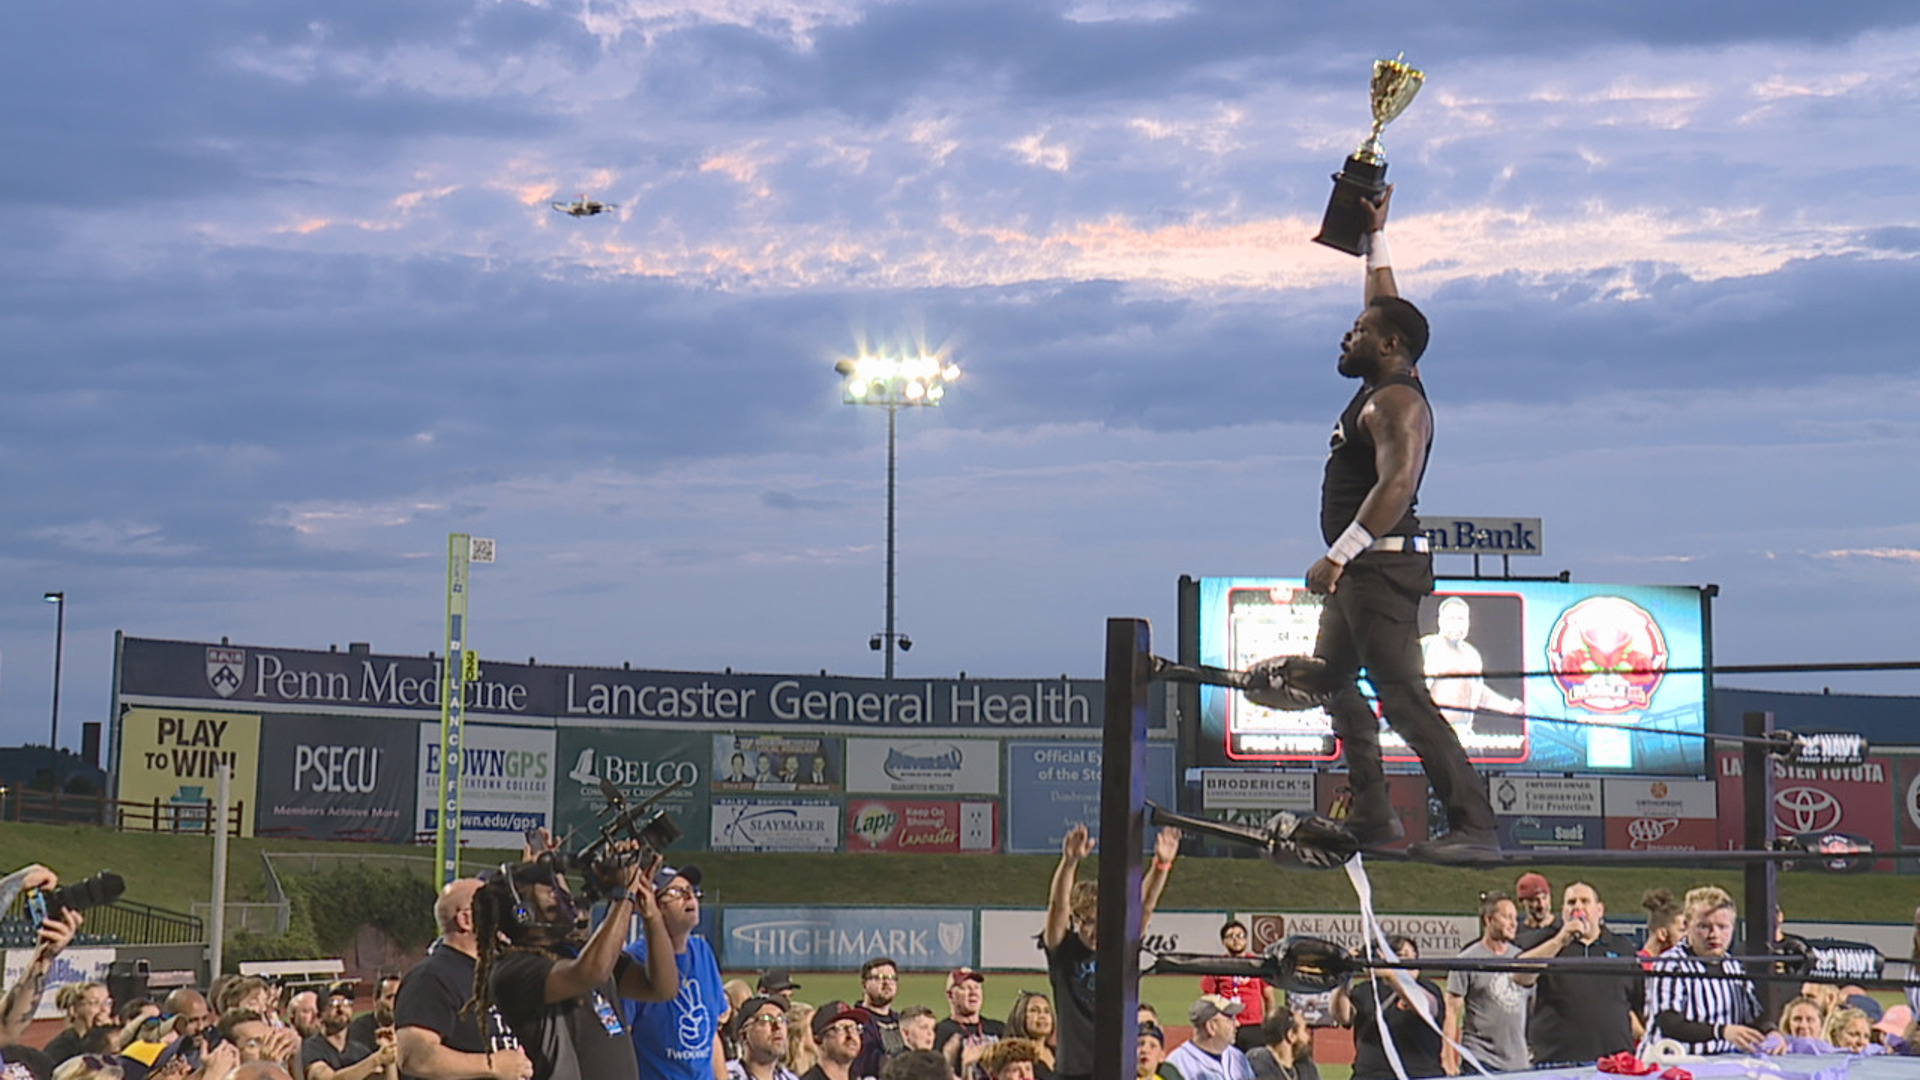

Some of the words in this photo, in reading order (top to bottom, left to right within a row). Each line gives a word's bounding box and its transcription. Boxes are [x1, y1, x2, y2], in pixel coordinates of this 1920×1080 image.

[1453, 521, 1536, 550] Bank
[465, 651, 475, 680] 320
[254, 653, 350, 700] Penn
[359, 660, 528, 711] Medcine
[567, 672, 756, 718] Lancaster
[769, 680, 933, 723] General
[951, 681, 1089, 724] Health
[157, 717, 228, 748] PLAY
[1034, 750, 1085, 763] Official
[1821, 733, 1861, 757] NAVY
[144, 752, 169, 770] TO
[171, 749, 236, 779] WIN!
[294, 744, 378, 793] PSECU
[605, 756, 698, 787] BELCO
[1038, 767, 1054, 780] of
[1056, 767, 1079, 780] the
[1207, 779, 1311, 790] BRODERICK'S
[1525, 792, 1594, 801] Commonwealth
[273, 805, 325, 817] Members
[327, 806, 368, 817] Achieve
[371, 807, 400, 817] More
[931, 807, 945, 817] On
[1526, 801, 1543, 810] Fire
[1547, 802, 1591, 811] Protection
[750, 820, 825, 832] SLAYMAKER
[853, 811, 899, 835] Lapp
[1287, 918, 1323, 933] A&E
[1329, 918, 1449, 935] AUOLOGY
[754, 928, 930, 956] HIGHMARK
[1835, 948, 1876, 972] NAVY
